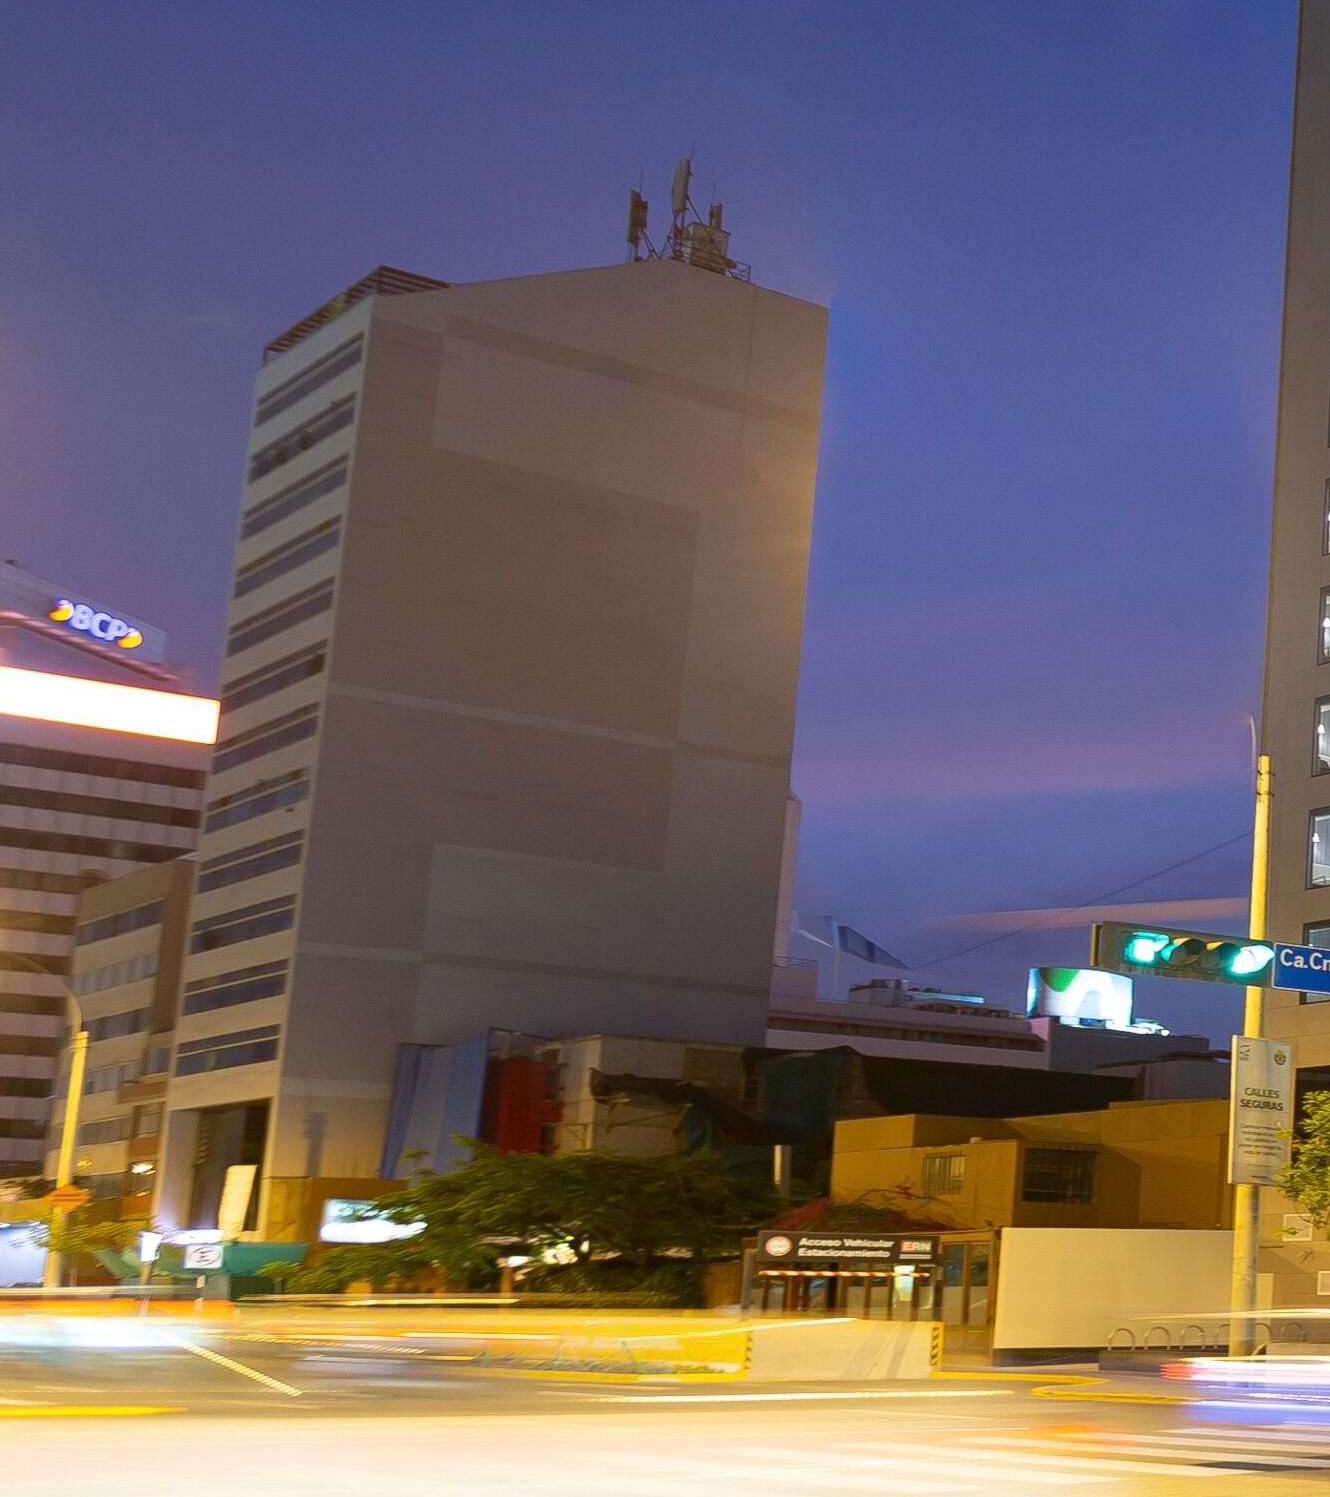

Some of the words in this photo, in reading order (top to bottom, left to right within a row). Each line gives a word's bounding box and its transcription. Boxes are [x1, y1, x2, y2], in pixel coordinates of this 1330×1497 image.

[71, 602, 129, 641] BCP
[1279, 948, 1309, 969] Ca.
[1244, 1087, 1280, 1099] CALLES
[1240, 1098, 1285, 1112] SEGURAS
[798, 1238, 842, 1247] Acceso
[843, 1238, 895, 1248] Vehicular
[797, 1248, 892, 1258] Estacionamiento
